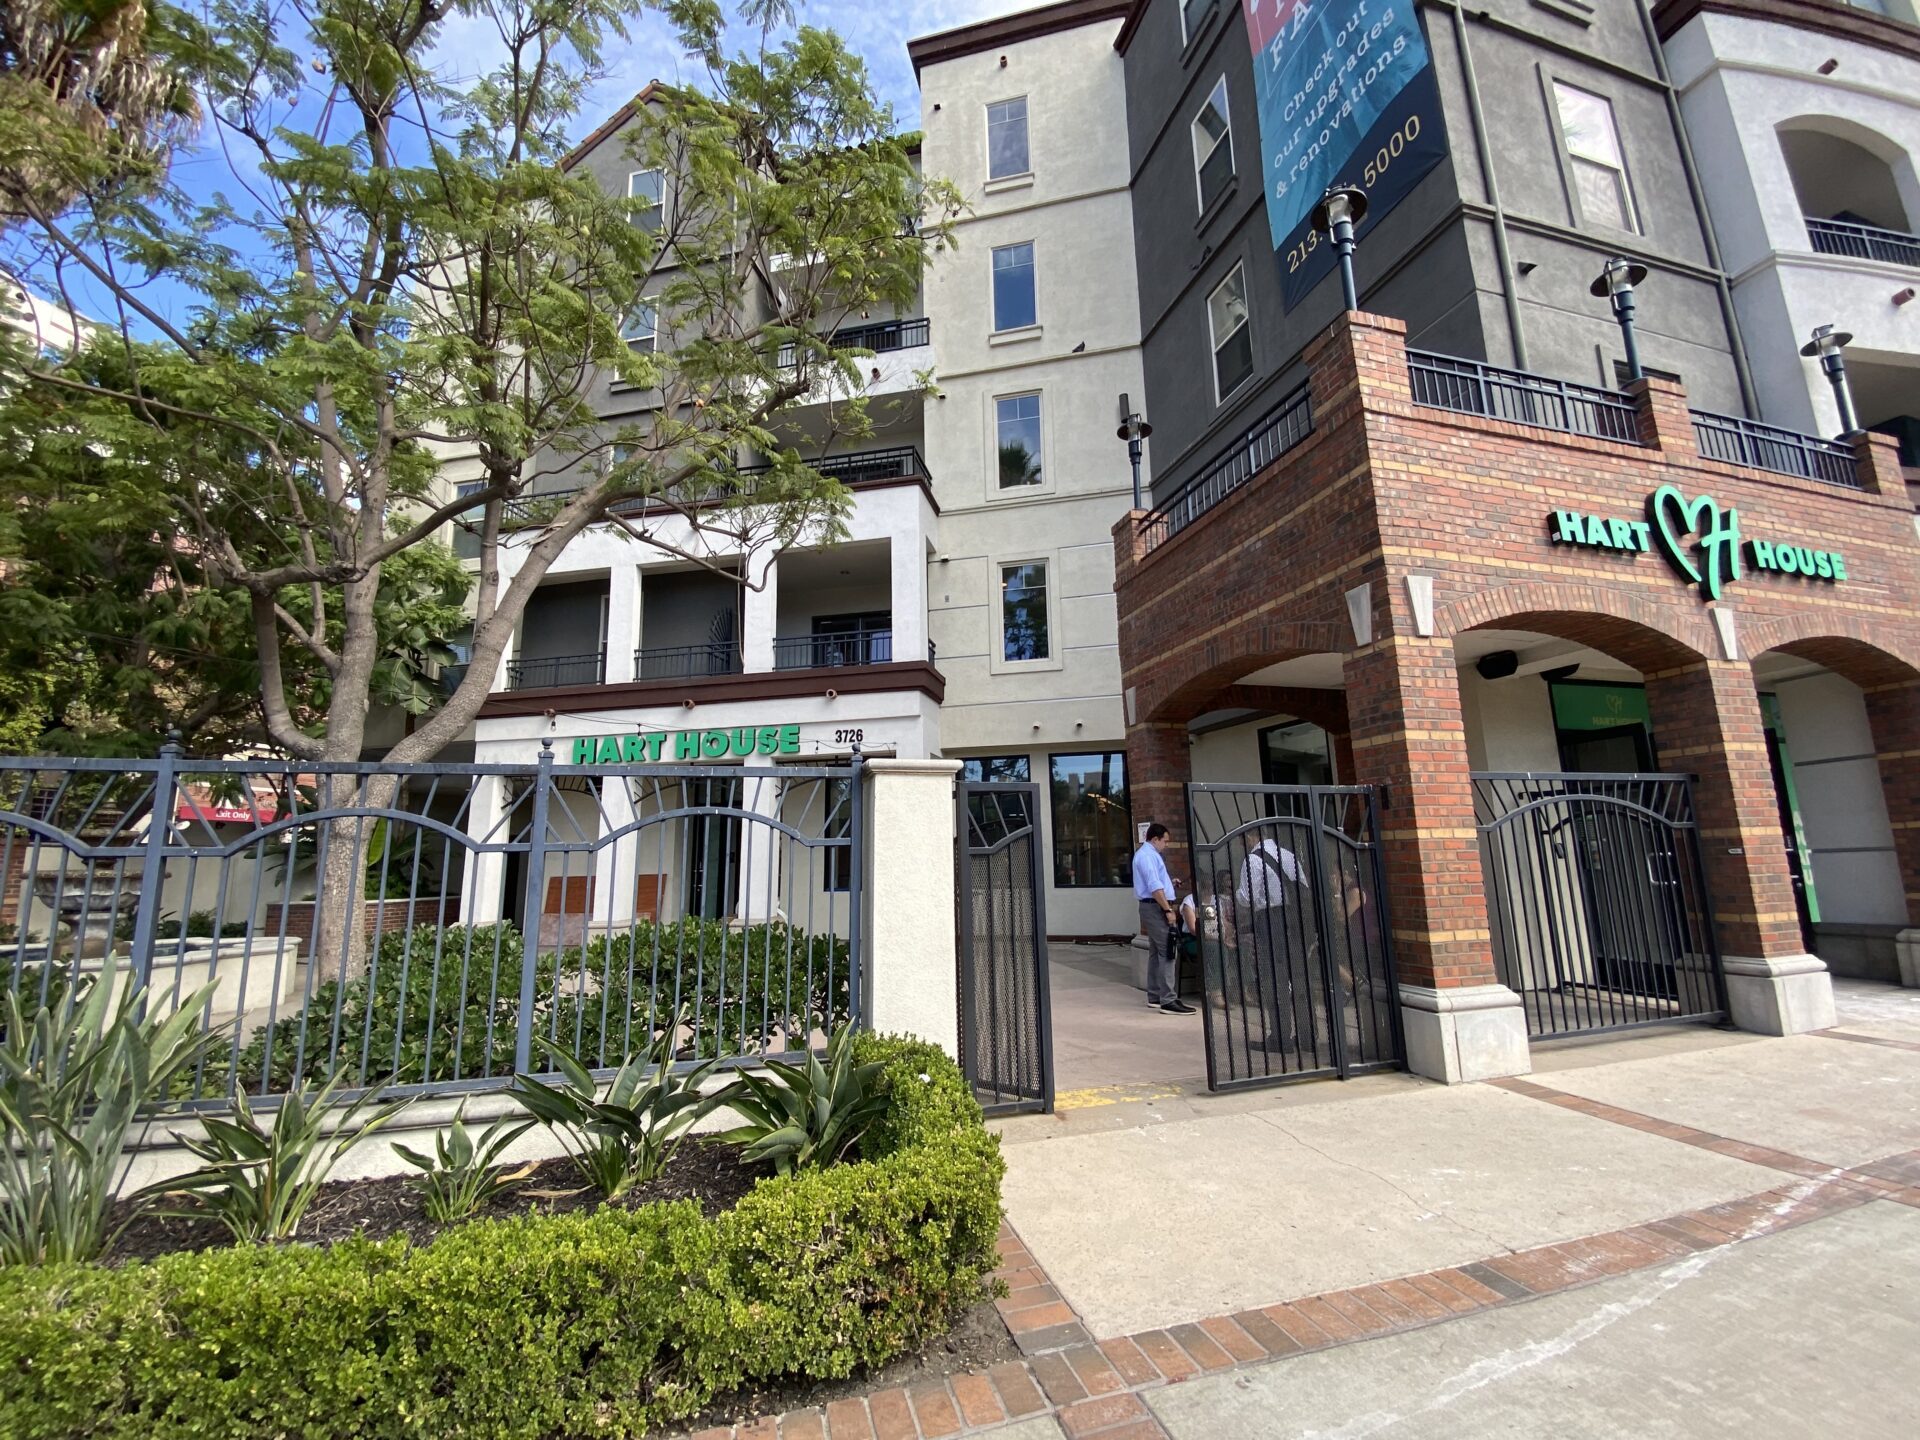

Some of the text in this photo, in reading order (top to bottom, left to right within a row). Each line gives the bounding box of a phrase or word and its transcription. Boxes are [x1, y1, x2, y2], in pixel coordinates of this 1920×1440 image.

[1336, 0, 1368, 48] out
[1275, 7, 1395, 168] our upgrades
[1276, 35, 1406, 199] & renovations
[1555, 510, 1650, 552] HART
[1751, 539, 1848, 581] HOUSE
[572, 725, 801, 765] HART HOUSE
[835, 729, 864, 743] 3726
[232, 811, 251, 821] Only
